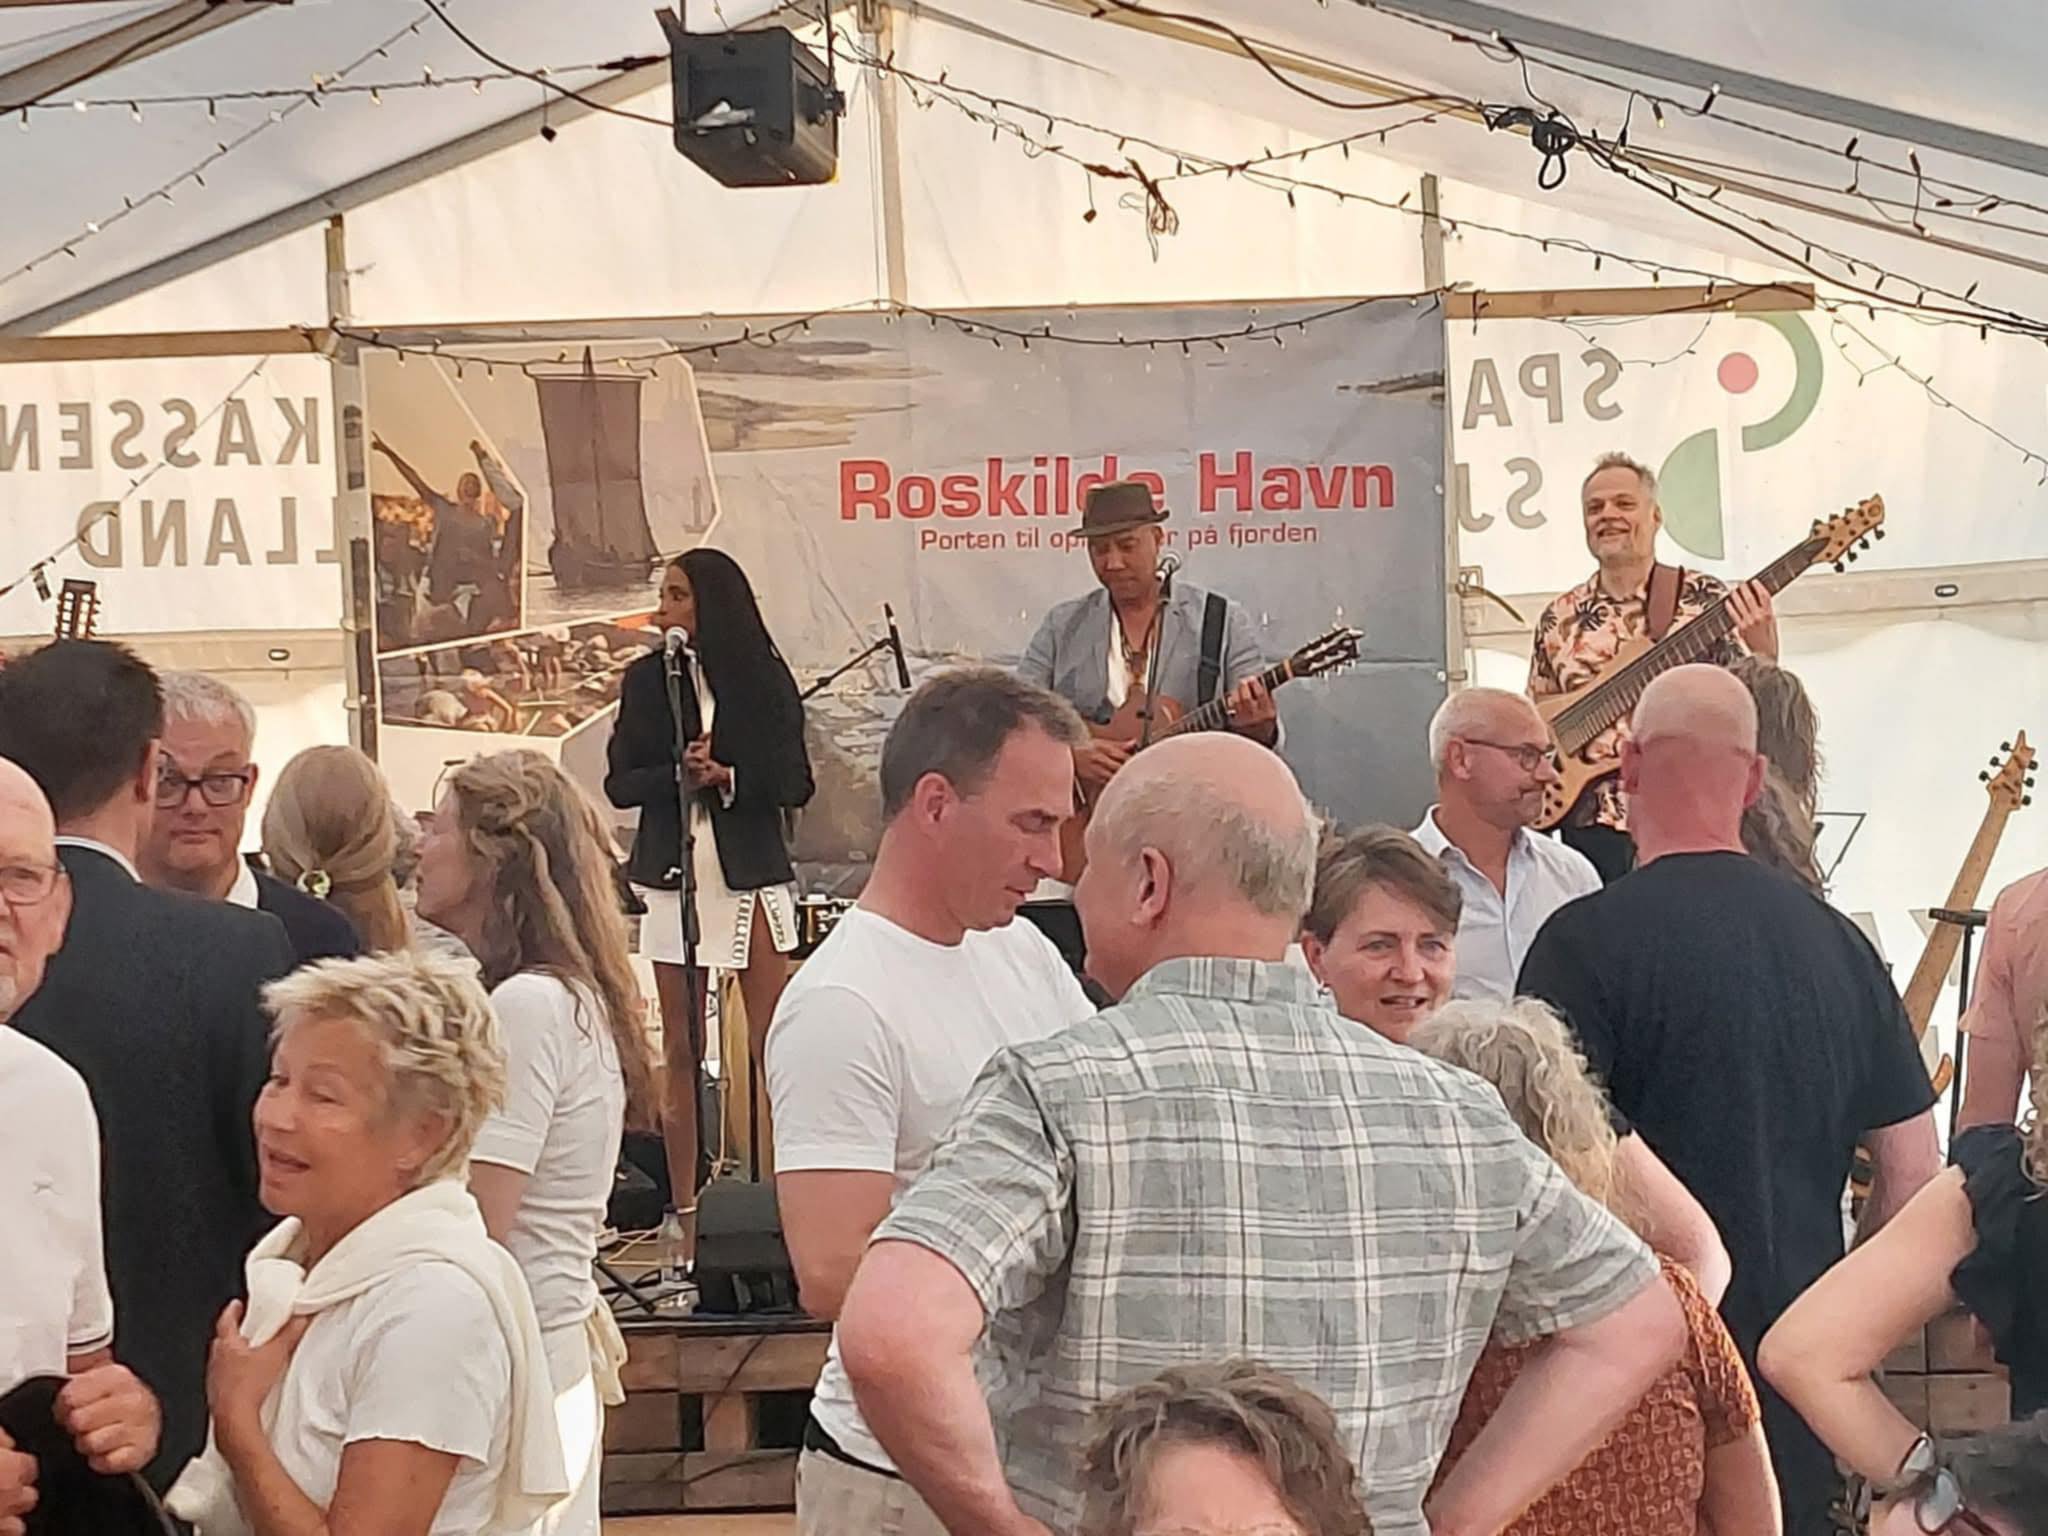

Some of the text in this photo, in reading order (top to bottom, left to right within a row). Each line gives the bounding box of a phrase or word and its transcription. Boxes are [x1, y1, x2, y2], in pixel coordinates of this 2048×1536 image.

[1200, 451, 1394, 512] Havn
[920, 529, 1005, 550] Porten
[1016, 527, 1039, 548] til
[1188, 524, 1218, 551] på
[1229, 522, 1317, 548] fjorden
